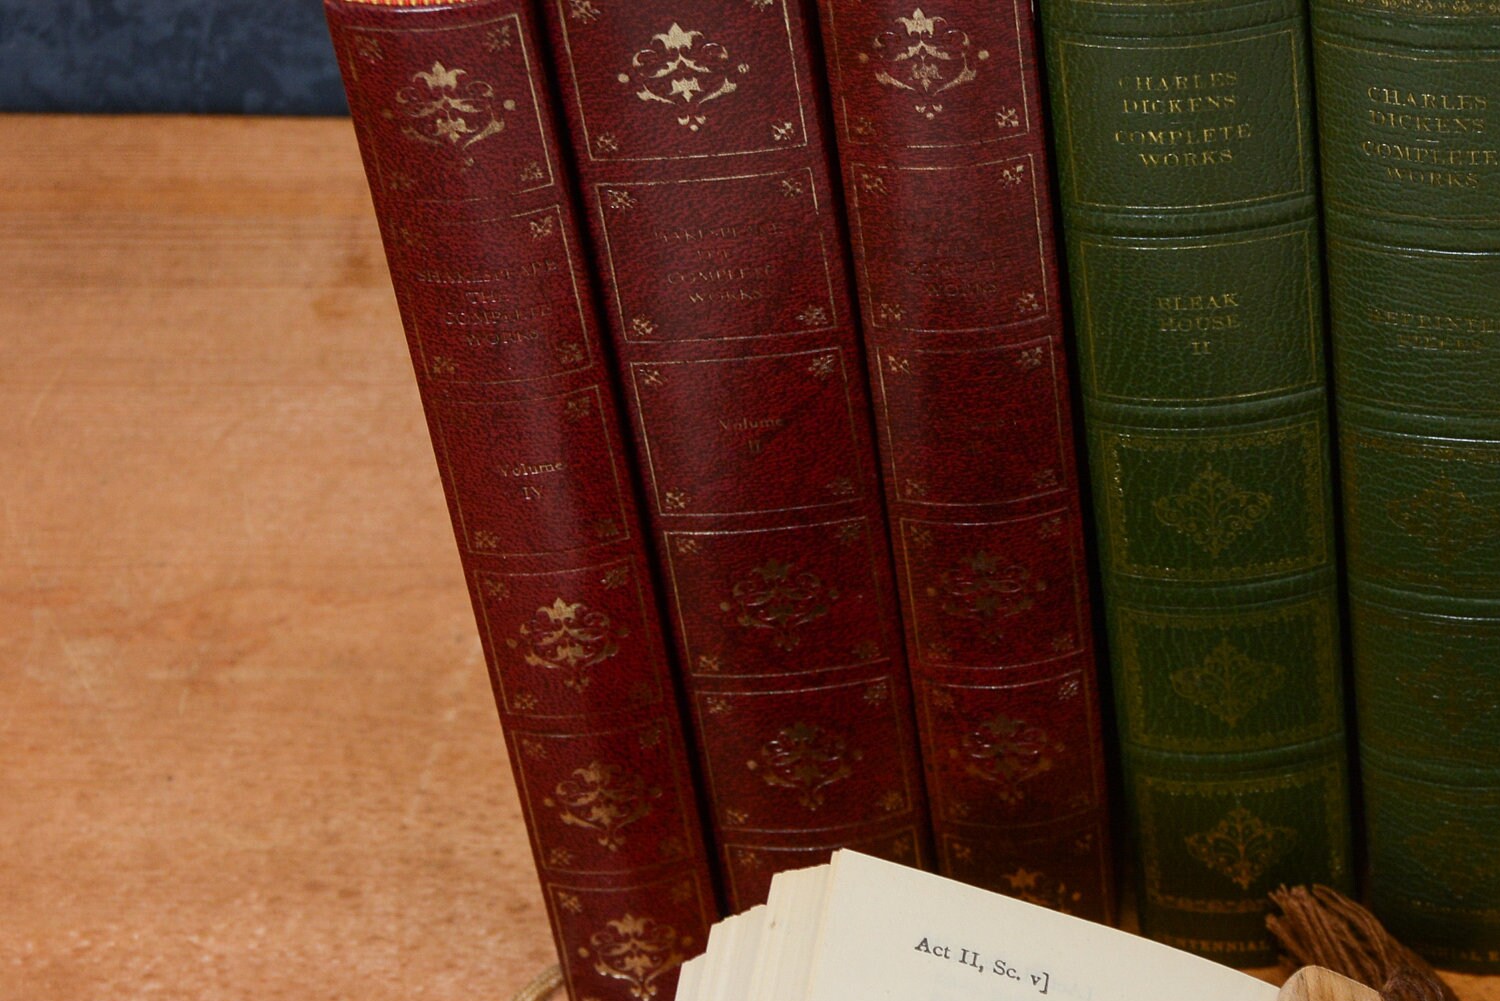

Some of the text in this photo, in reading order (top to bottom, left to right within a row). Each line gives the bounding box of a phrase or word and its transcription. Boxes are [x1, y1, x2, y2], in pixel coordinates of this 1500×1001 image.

[1118, 70, 1238, 93] CHARLES
[1122, 94, 1237, 115] DICKENS
[1366, 86, 1489, 109] CHARLES
[1368, 109, 1486, 134] DICKENS
[1114, 122, 1253, 147] COMPLETE
[1138, 148, 1234, 168] WORKS
[1361, 139, 1499, 167] COMPLETE
[1385, 165, 1481, 189] WORKS
[1190, 340, 1212, 355] II
[718, 417, 785, 432] Volume
[501, 462, 567, 478] Volume
[914, 937, 1050, 995] Act II, Sc. v]
